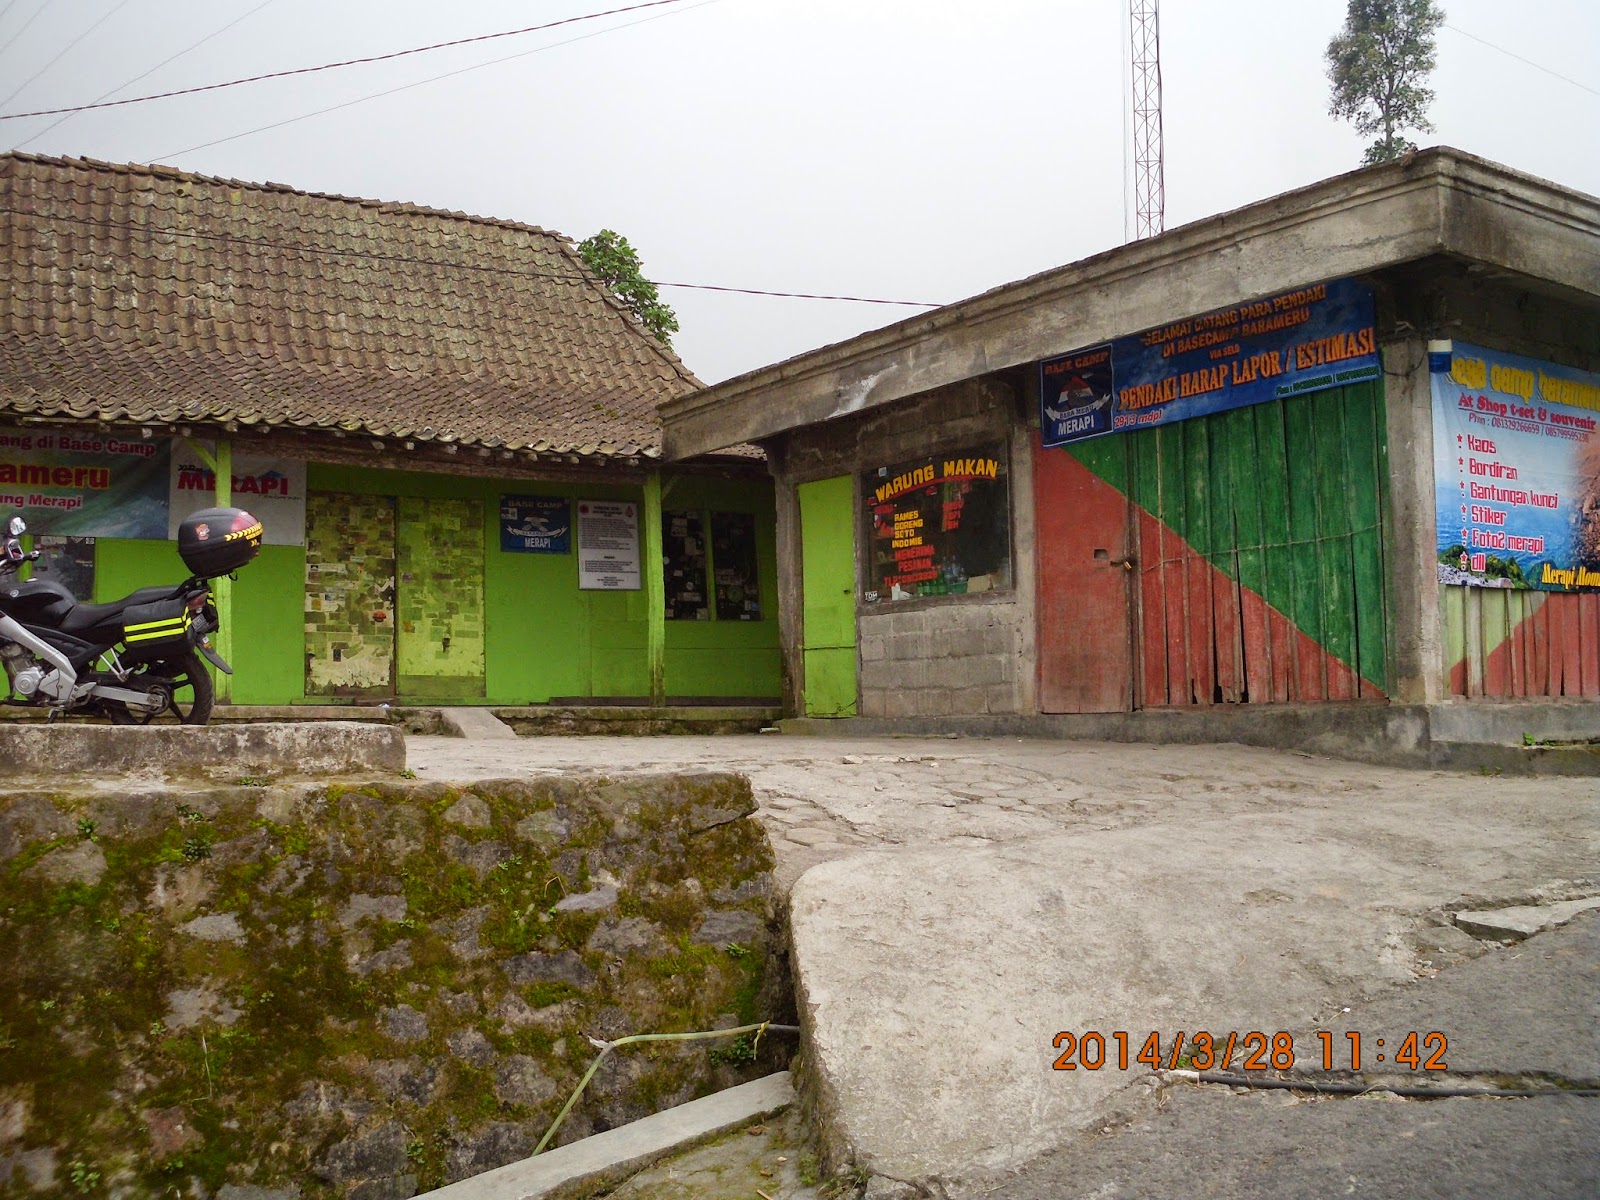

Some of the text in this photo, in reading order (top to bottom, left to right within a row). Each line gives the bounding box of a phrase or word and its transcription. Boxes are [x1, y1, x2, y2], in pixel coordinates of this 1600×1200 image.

[1143, 320, 1192, 346] SELAMAT
[1240, 299, 1274, 321] PARA
[1274, 284, 1327, 313] PENDAKI
[1241, 307, 1311, 338] BARAMERU
[1045, 361, 1073, 375] BASE
[1118, 375, 1178, 411] PENDAKI
[1179, 363, 1229, 398] HARAP
[1231, 350, 1282, 385] LAPOR
[1285, 346, 1294, 373] /
[1296, 327, 1376, 369] ESTIMASI
[1458, 392, 1474, 408] At
[1477, 395, 1508, 417] Shop
[1550, 411, 1597, 431] souvenir
[1058, 415, 1095, 436] MERAPI
[37, 435, 54, 449] di
[58, 436, 103, 452] Base
[107, 439, 156, 457] Camp
[1467, 434, 1497, 454] Kaos
[875, 458, 998, 502] WARUNG MAKAN
[1469, 457, 1518, 481] Bordiran
[28, 494, 83, 510] Merapi
[1469, 481, 1559, 509] Gantungan kunci
[894, 510, 919, 521] RAMES
[894, 519, 923, 531] GORENG
[1471, 505, 1507, 526] Stiker
[524, 537, 551, 549] MERAPI
[1472, 528, 1544, 555] Foto2 merapi
[1471, 553, 1487, 572] dll
[1541, 563, 1576, 590] Merapi
